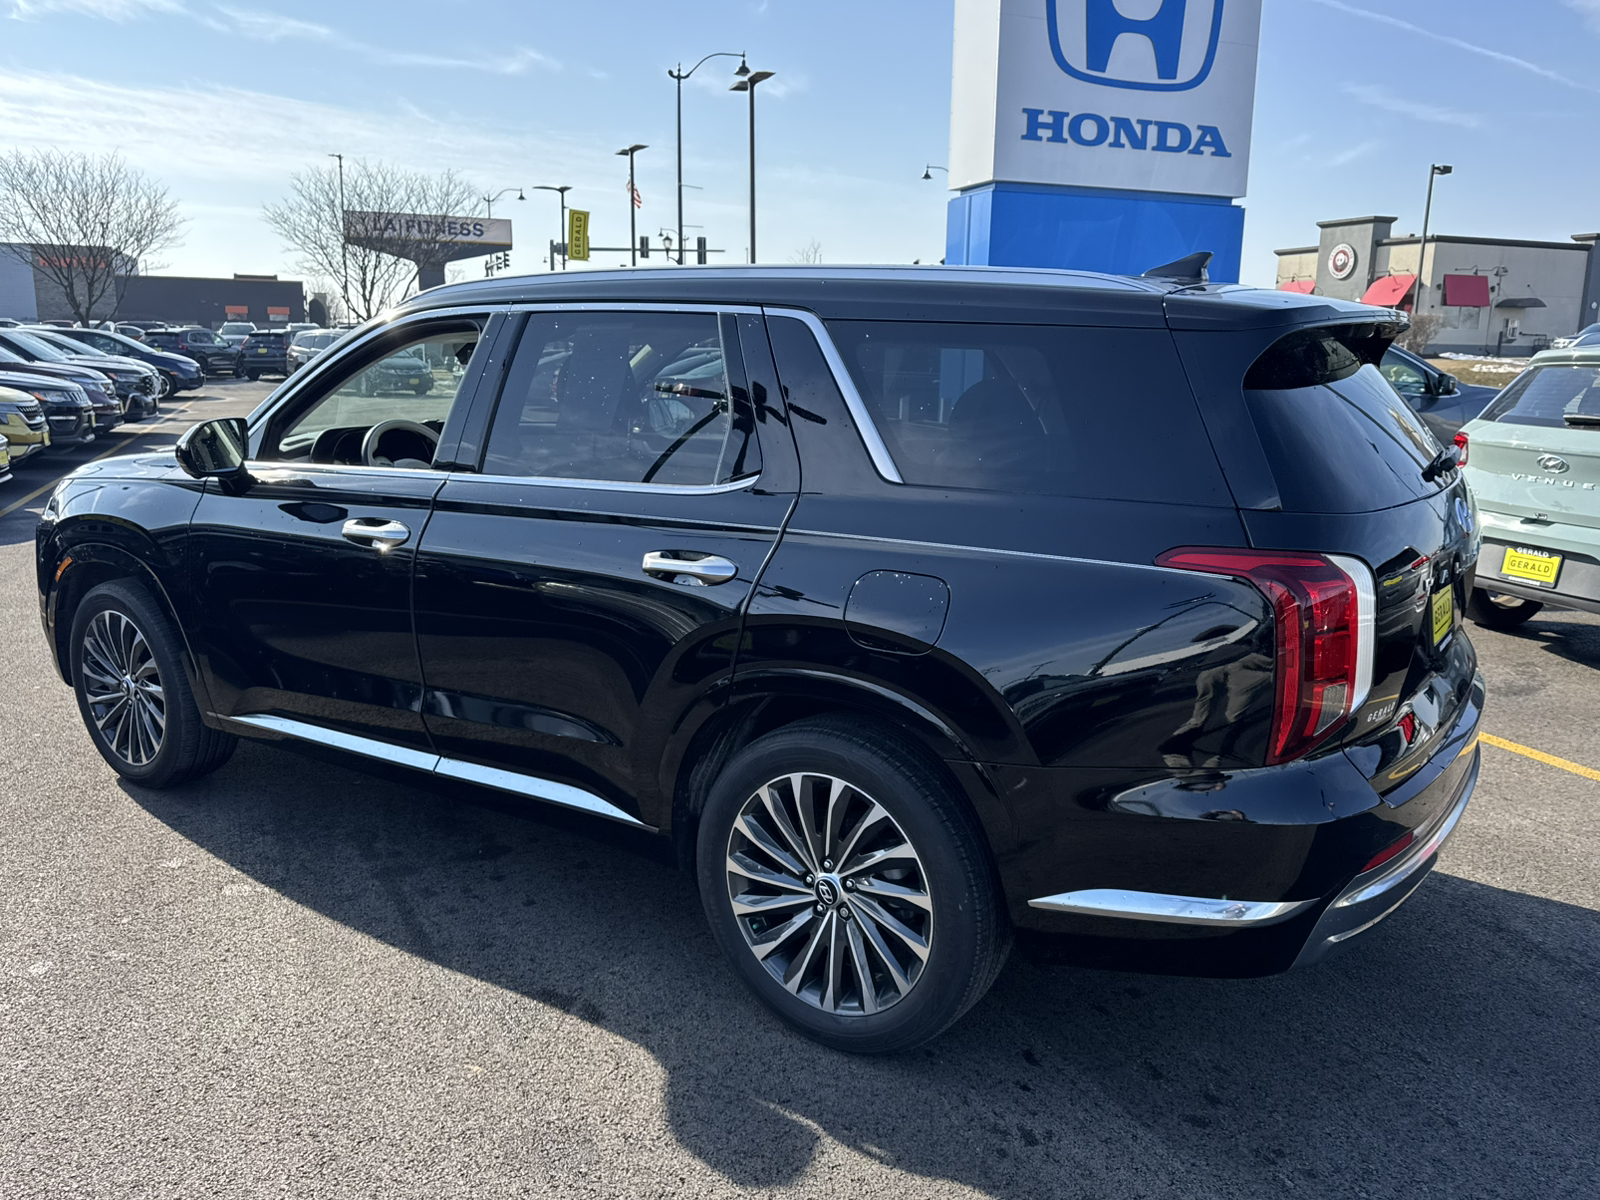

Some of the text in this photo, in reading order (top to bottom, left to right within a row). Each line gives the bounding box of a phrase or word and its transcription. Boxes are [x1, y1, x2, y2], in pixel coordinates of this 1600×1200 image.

[1021, 107, 1232, 158] HONDA
[406, 219, 484, 237] FITNESS
[574, 216, 583, 255] GERALD
[1511, 473, 1595, 490] VENUE
[1516, 547, 1550, 558] GERALD
[1510, 559, 1550, 573] GERALD
[1367, 701, 1396, 722] GERALD
